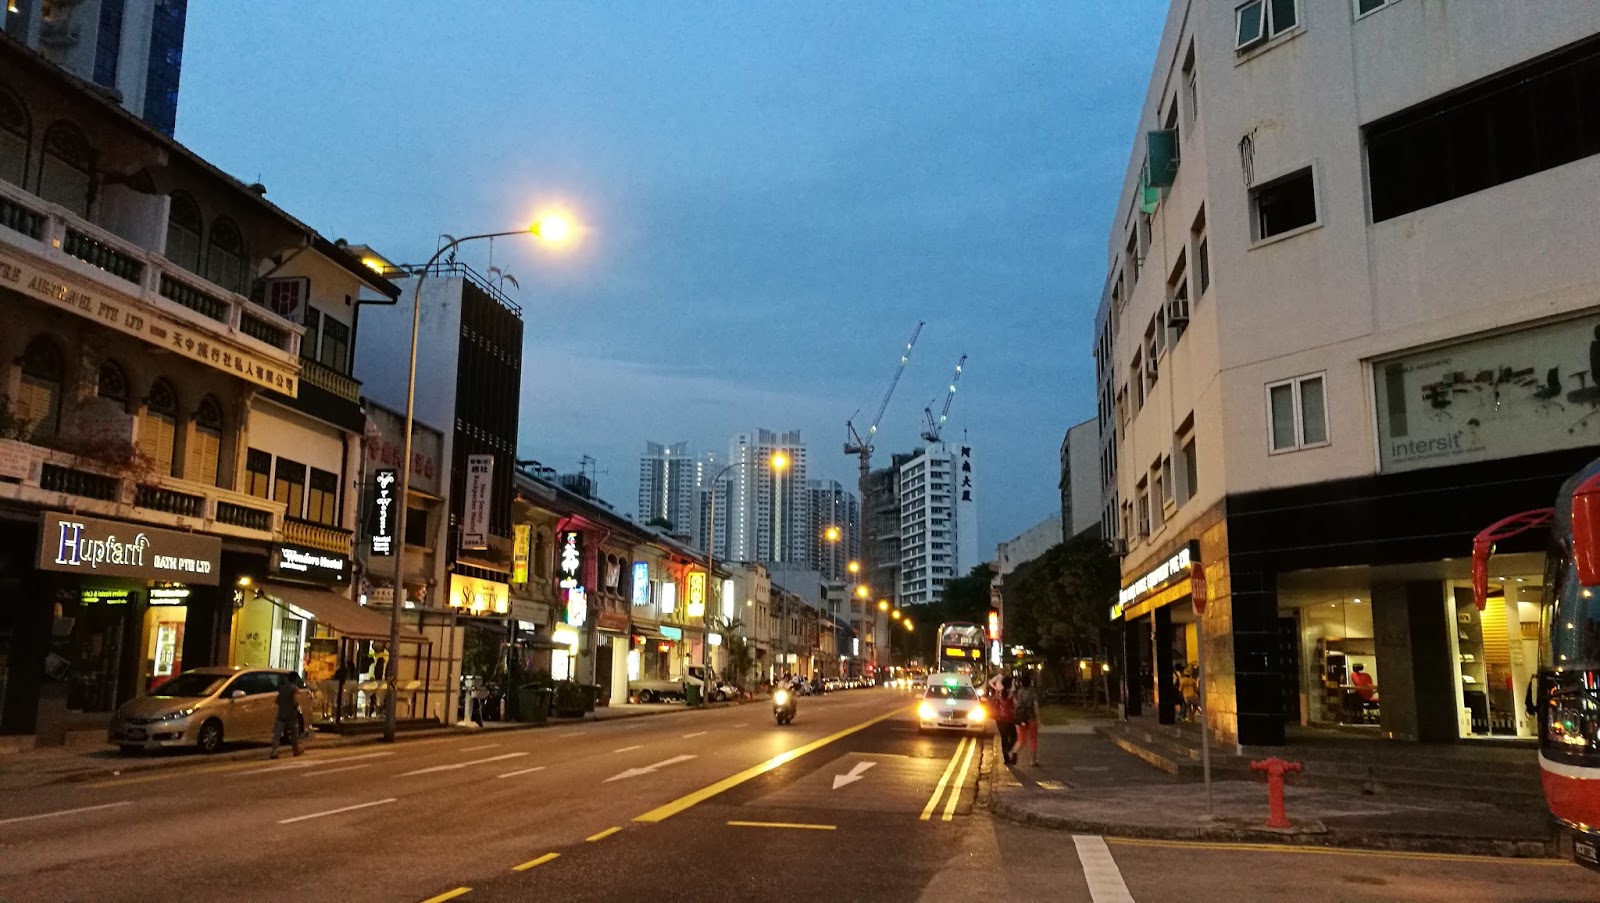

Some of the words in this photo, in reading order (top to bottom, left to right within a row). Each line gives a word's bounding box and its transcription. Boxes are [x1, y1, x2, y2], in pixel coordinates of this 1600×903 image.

[97, 301, 119, 322] PTE
[124, 312, 144, 331] LTD
[1391, 432, 1460, 457] intersit
[154, 555, 177, 570] BATH
[179, 558, 195, 572] PTE
[196, 560, 211, 574] LTD
[462, 586, 498, 609] SOETY
[1193, 578, 1206, 600] STOP
